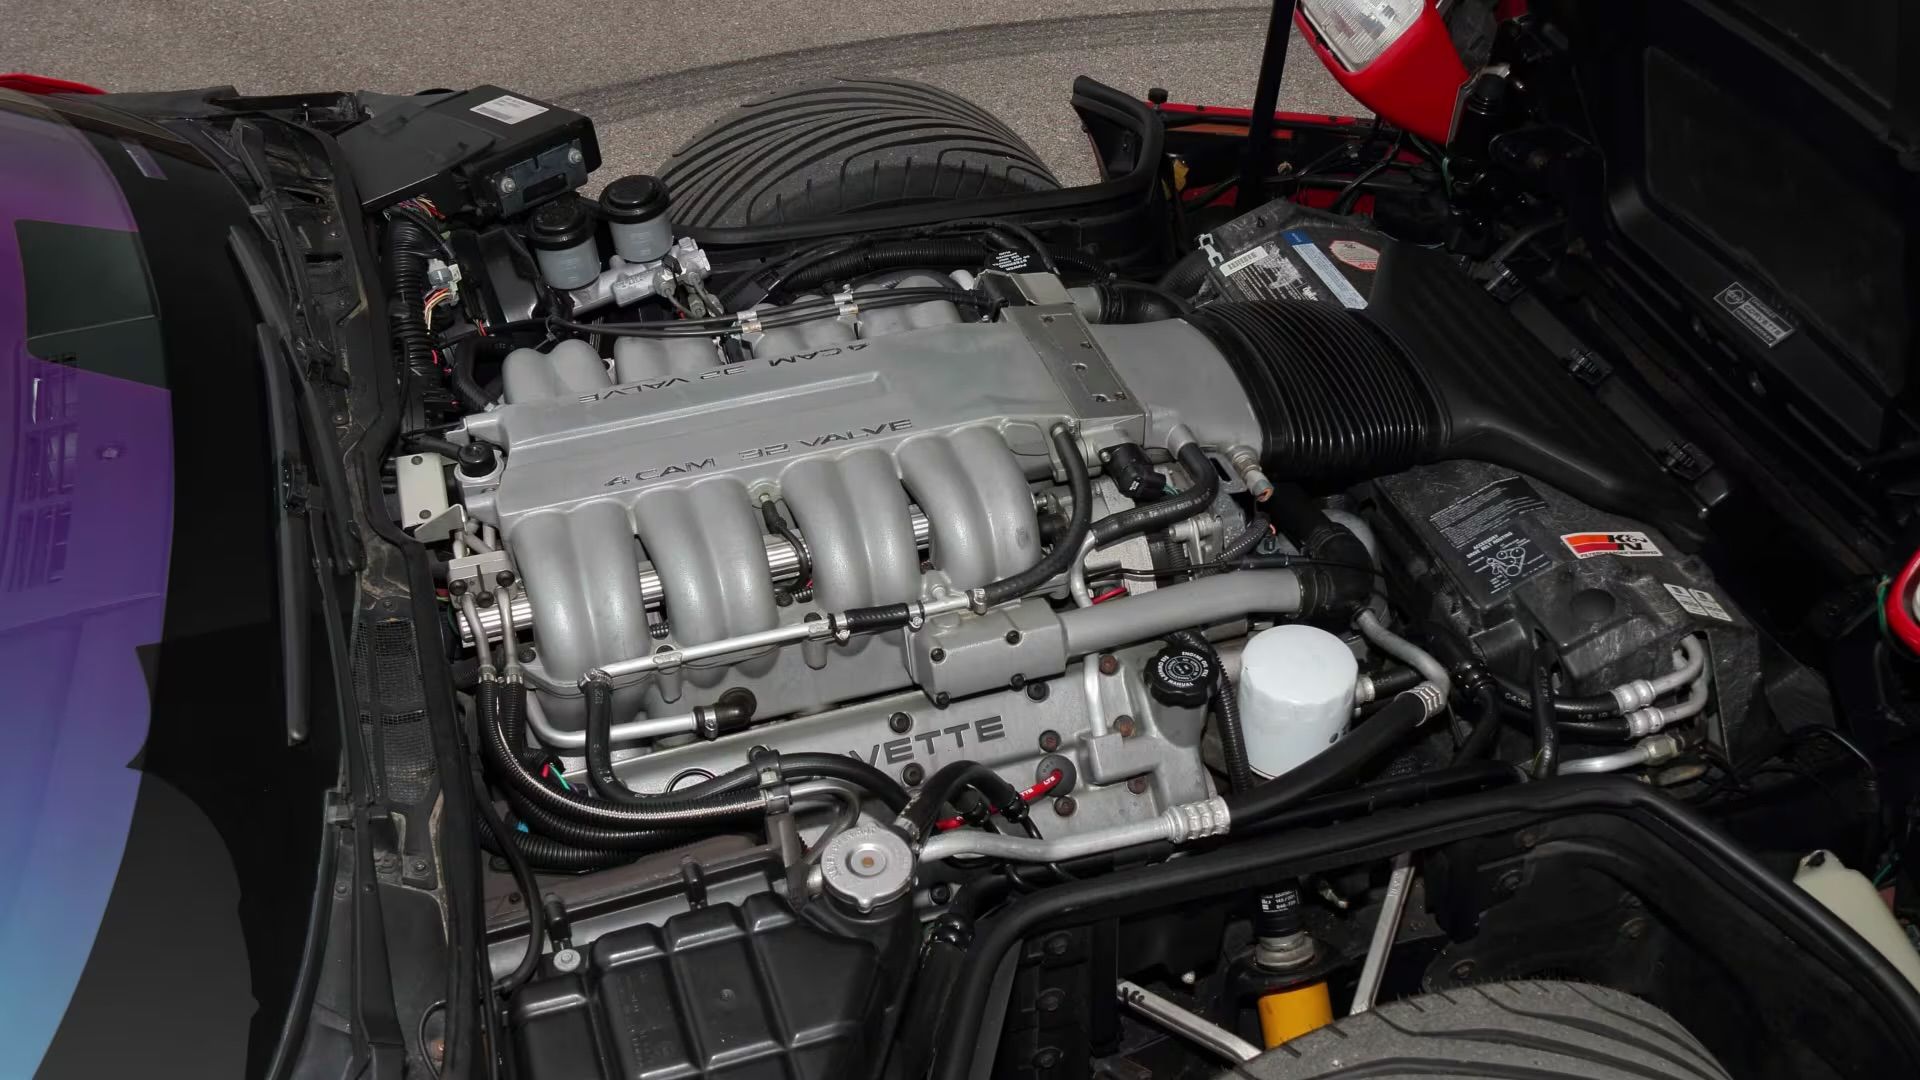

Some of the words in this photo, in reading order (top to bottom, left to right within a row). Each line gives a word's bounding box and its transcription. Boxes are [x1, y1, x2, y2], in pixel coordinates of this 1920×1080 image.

[1743, 304, 1784, 336] CORVETTE
[768, 347, 843, 368] CAM
[848, 341, 871, 353] 4
[700, 365, 746, 380] 32
[579, 376, 690, 403] VALVE
[604, 474, 630, 487] 4
[635, 456, 716, 480] CAM
[738, 443, 790, 460] 32
[797, 418, 913, 447] VALVE
[1607, 534, 1648, 551] K&N
[1181, 651, 1203, 661] ENGINE
[848, 715, 1006, 767] VETTE
